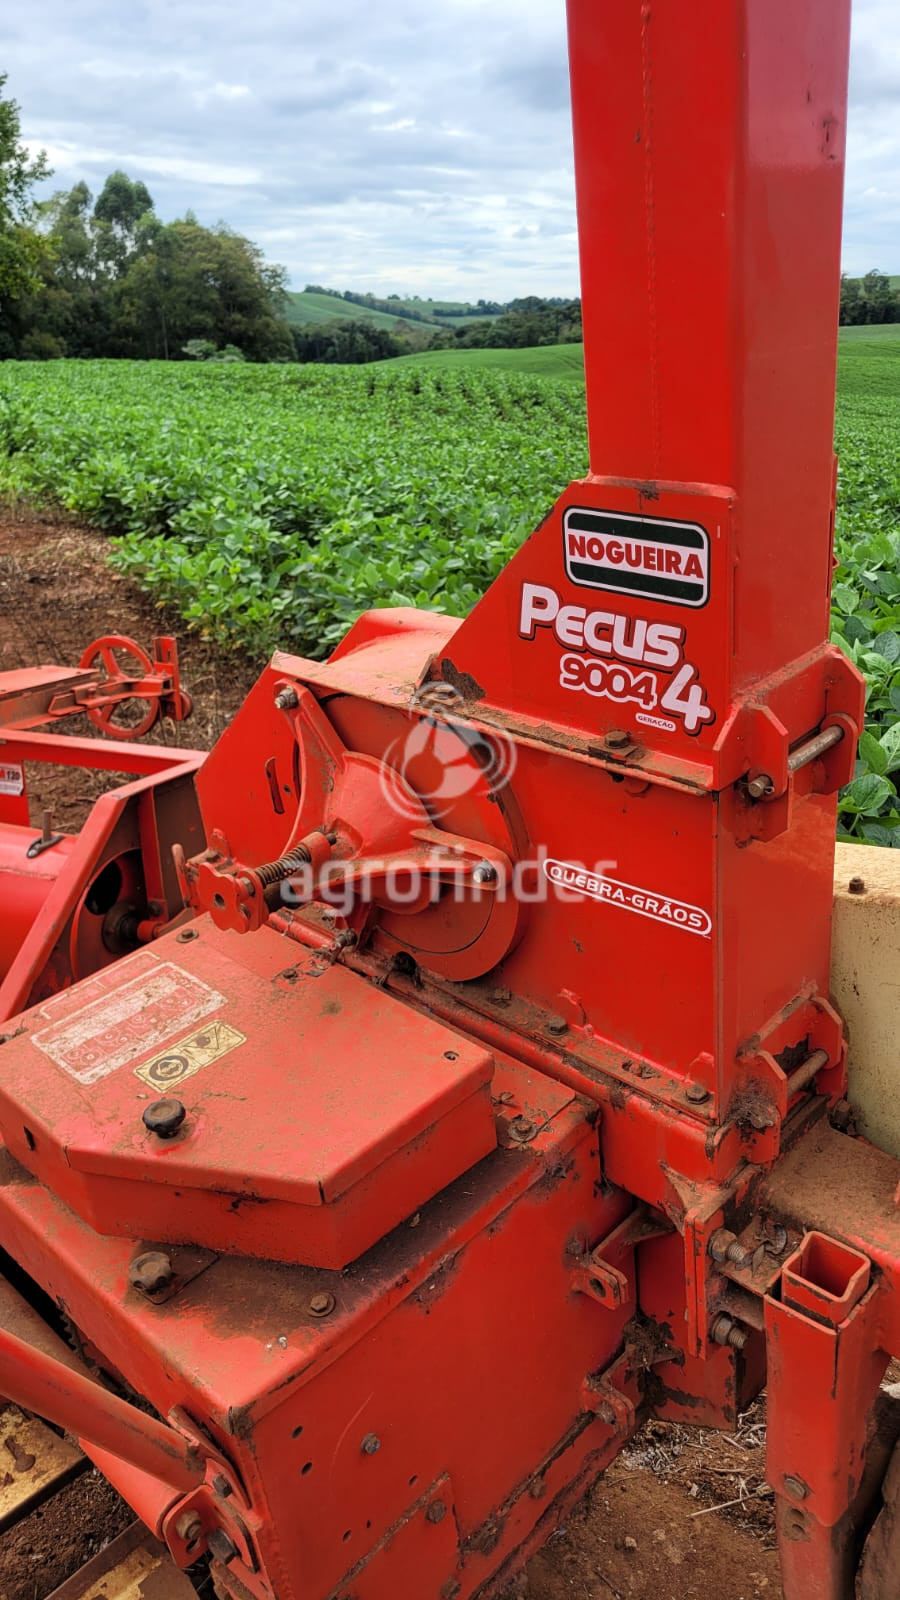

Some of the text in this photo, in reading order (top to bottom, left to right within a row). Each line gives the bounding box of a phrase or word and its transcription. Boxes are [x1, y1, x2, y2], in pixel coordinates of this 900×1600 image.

[567, 533, 704, 579] NOGUEIRA
[559, 653, 712, 731] 9004 4
[549, 864, 704, 929] QUEBRA-GRÃOS
